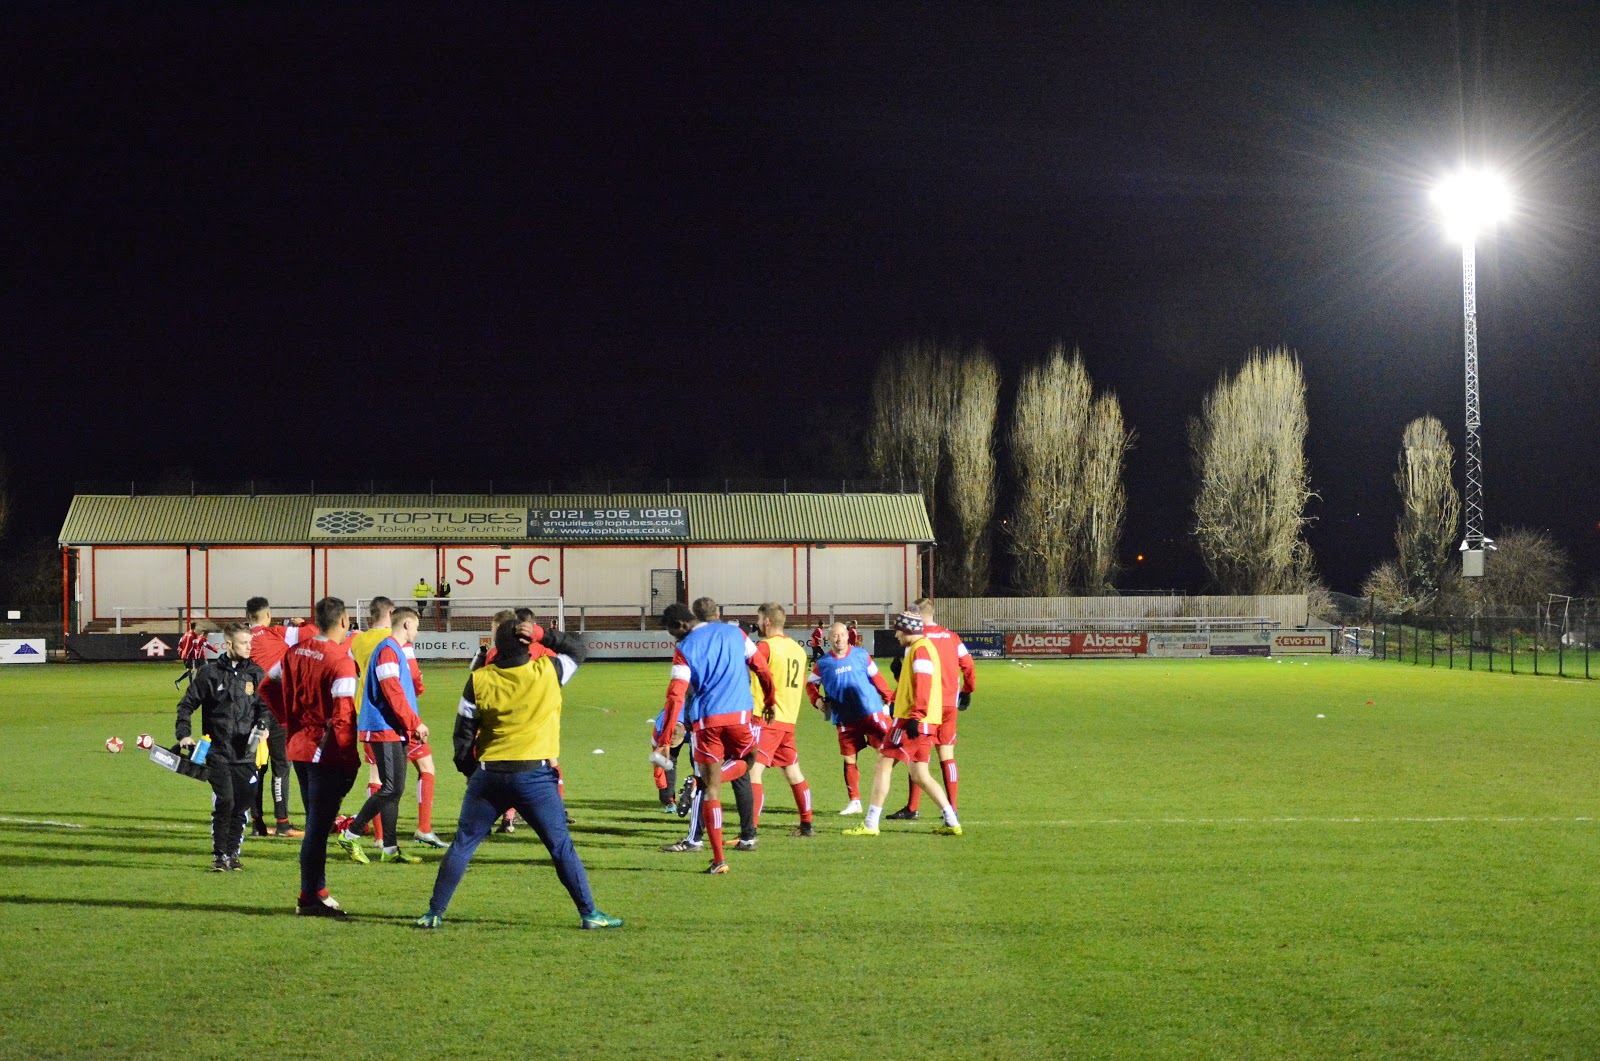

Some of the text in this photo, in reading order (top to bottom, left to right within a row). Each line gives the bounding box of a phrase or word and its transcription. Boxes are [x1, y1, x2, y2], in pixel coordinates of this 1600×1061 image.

[377, 512, 522, 524] TOPTUBES
[532, 509, 682, 519] T: 0121 506 1080
[543, 519, 685, 528] enquiries@toptubes.co.uk
[376, 525, 522, 534] Taking tube further
[560, 527, 672, 535] www.toptubes.co.uk
[1011, 633, 1071, 647] Abacus
[1082, 633, 1142, 647] Abacus
[1283, 636, 1323, 646] EVO-STIK
[451, 641, 470, 650] F.C.
[786, 658, 800, 688] 12
